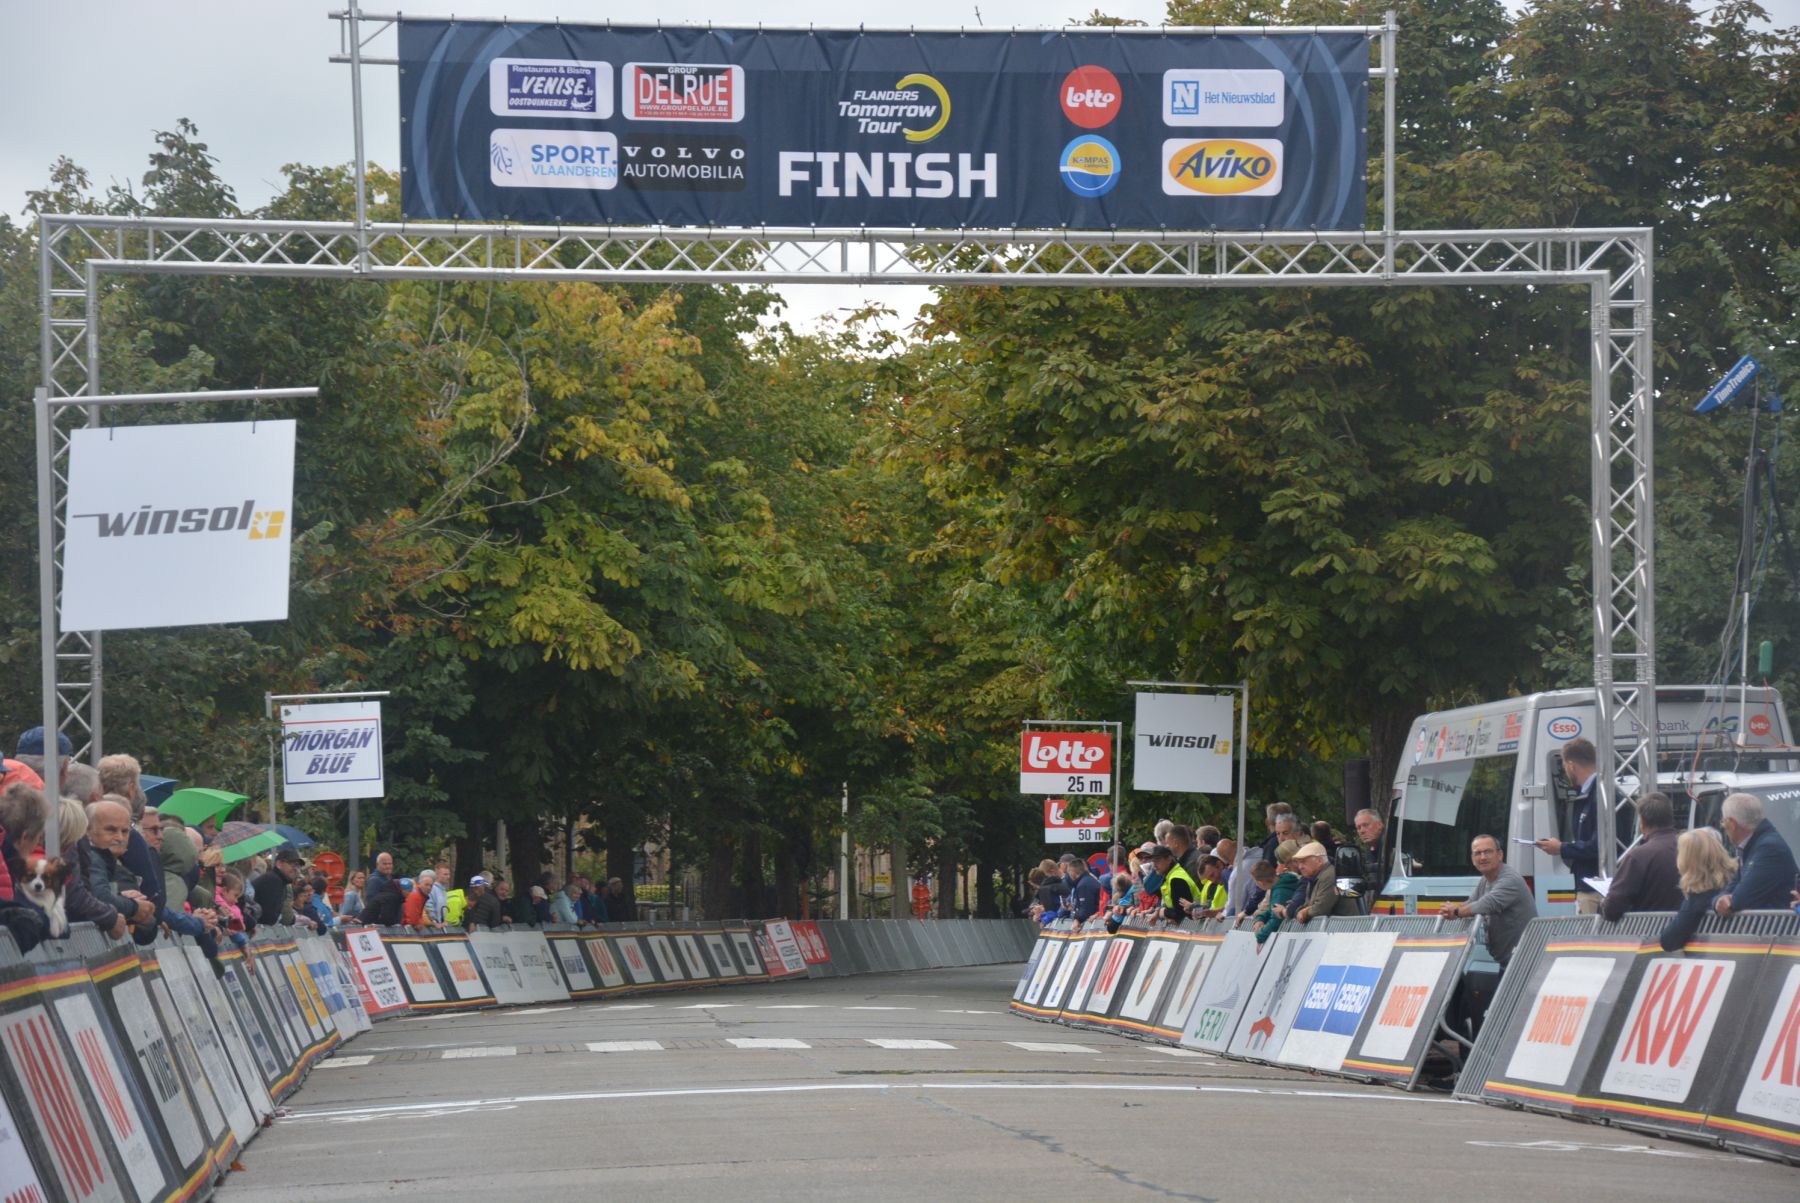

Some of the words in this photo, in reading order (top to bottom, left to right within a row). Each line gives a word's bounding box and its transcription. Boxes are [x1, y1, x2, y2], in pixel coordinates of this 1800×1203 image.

[512, 65, 557, 74] Restaurant
[559, 66, 566, 74] &
[567, 66, 592, 75] Bistro
[668, 66, 698, 74] GROUP
[640, 73, 729, 106] DELRUE
[853, 90, 919, 101] FLANDERS
[1204, 91, 1220, 104] Het
[1221, 91, 1277, 104] Nieuwsblad
[509, 97, 568, 107] OOSTDUINKERKE
[838, 101, 937, 118] Tomorrow
[858, 118, 902, 134] Tour
[622, 146, 745, 160] VOLVO
[532, 164, 618, 178] VLAANDEREN
[623, 164, 745, 180] AUTOMOBILIA
[779, 151, 998, 198] FINISH
[72, 499, 255, 538] winsol
[288, 727, 375, 752] MORGAN
[1137, 732, 1217, 749] winsol
[305, 752, 357, 775] BLUE
[1067, 776, 1085, 793] 25
[1090, 780, 1103, 793] m
[1078, 829, 1092, 841] 50
[1620, 963, 1725, 1069] KW
